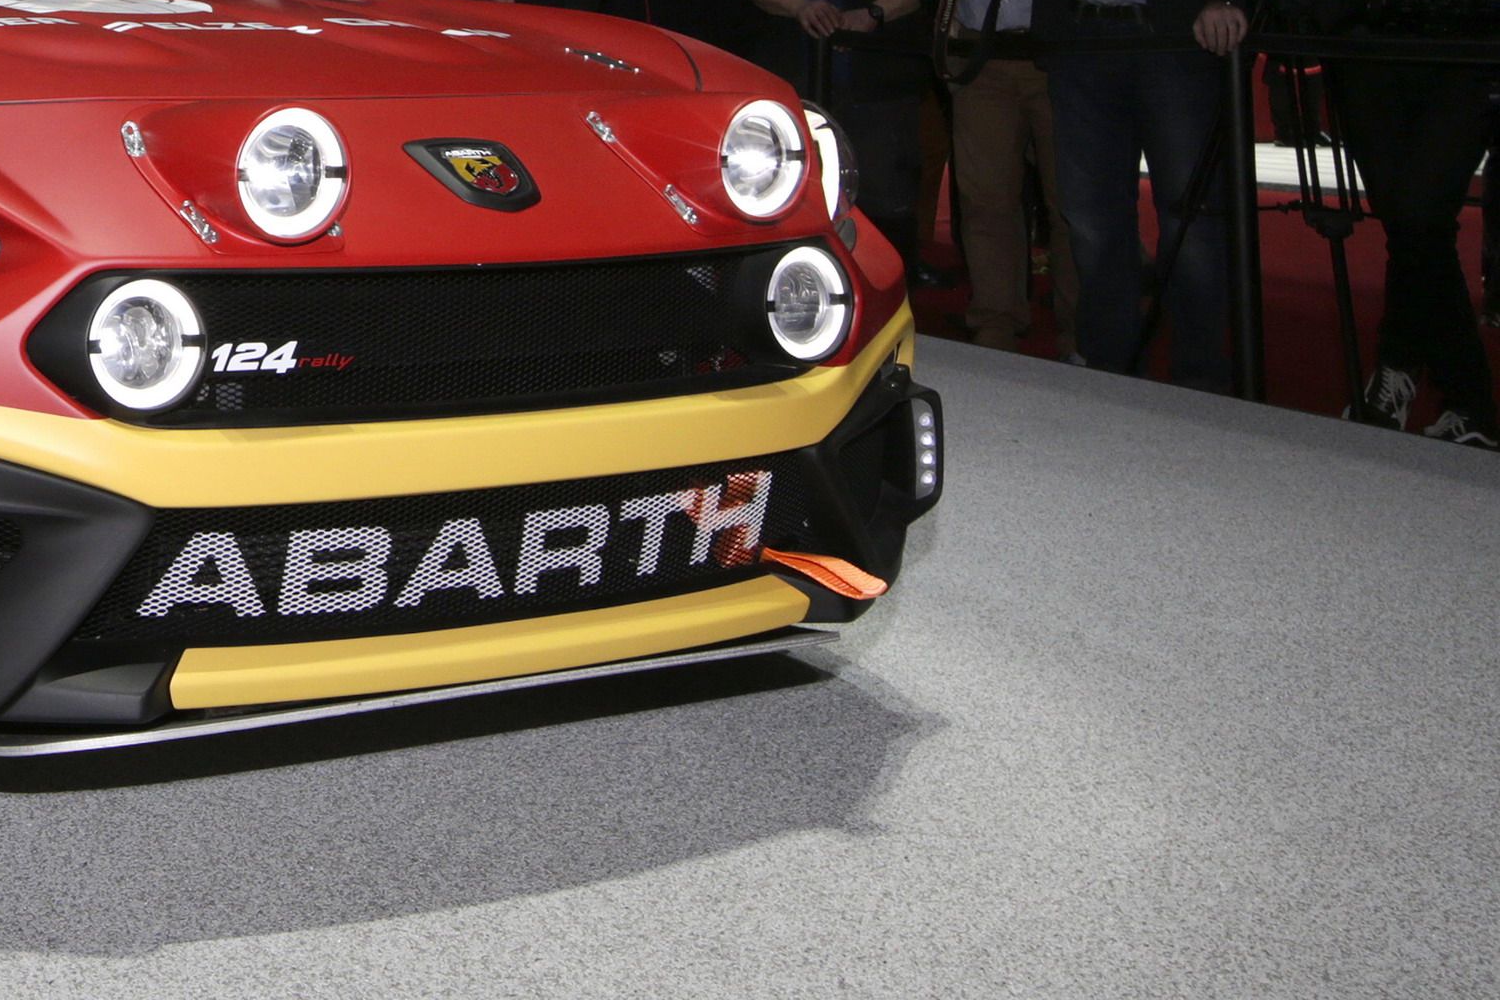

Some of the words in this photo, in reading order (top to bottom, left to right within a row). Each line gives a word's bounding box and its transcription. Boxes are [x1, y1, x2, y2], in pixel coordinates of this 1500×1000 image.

[211, 341, 298, 374] 124
[299, 352, 355, 371] rally
[135, 471, 773, 619] ABARTH
